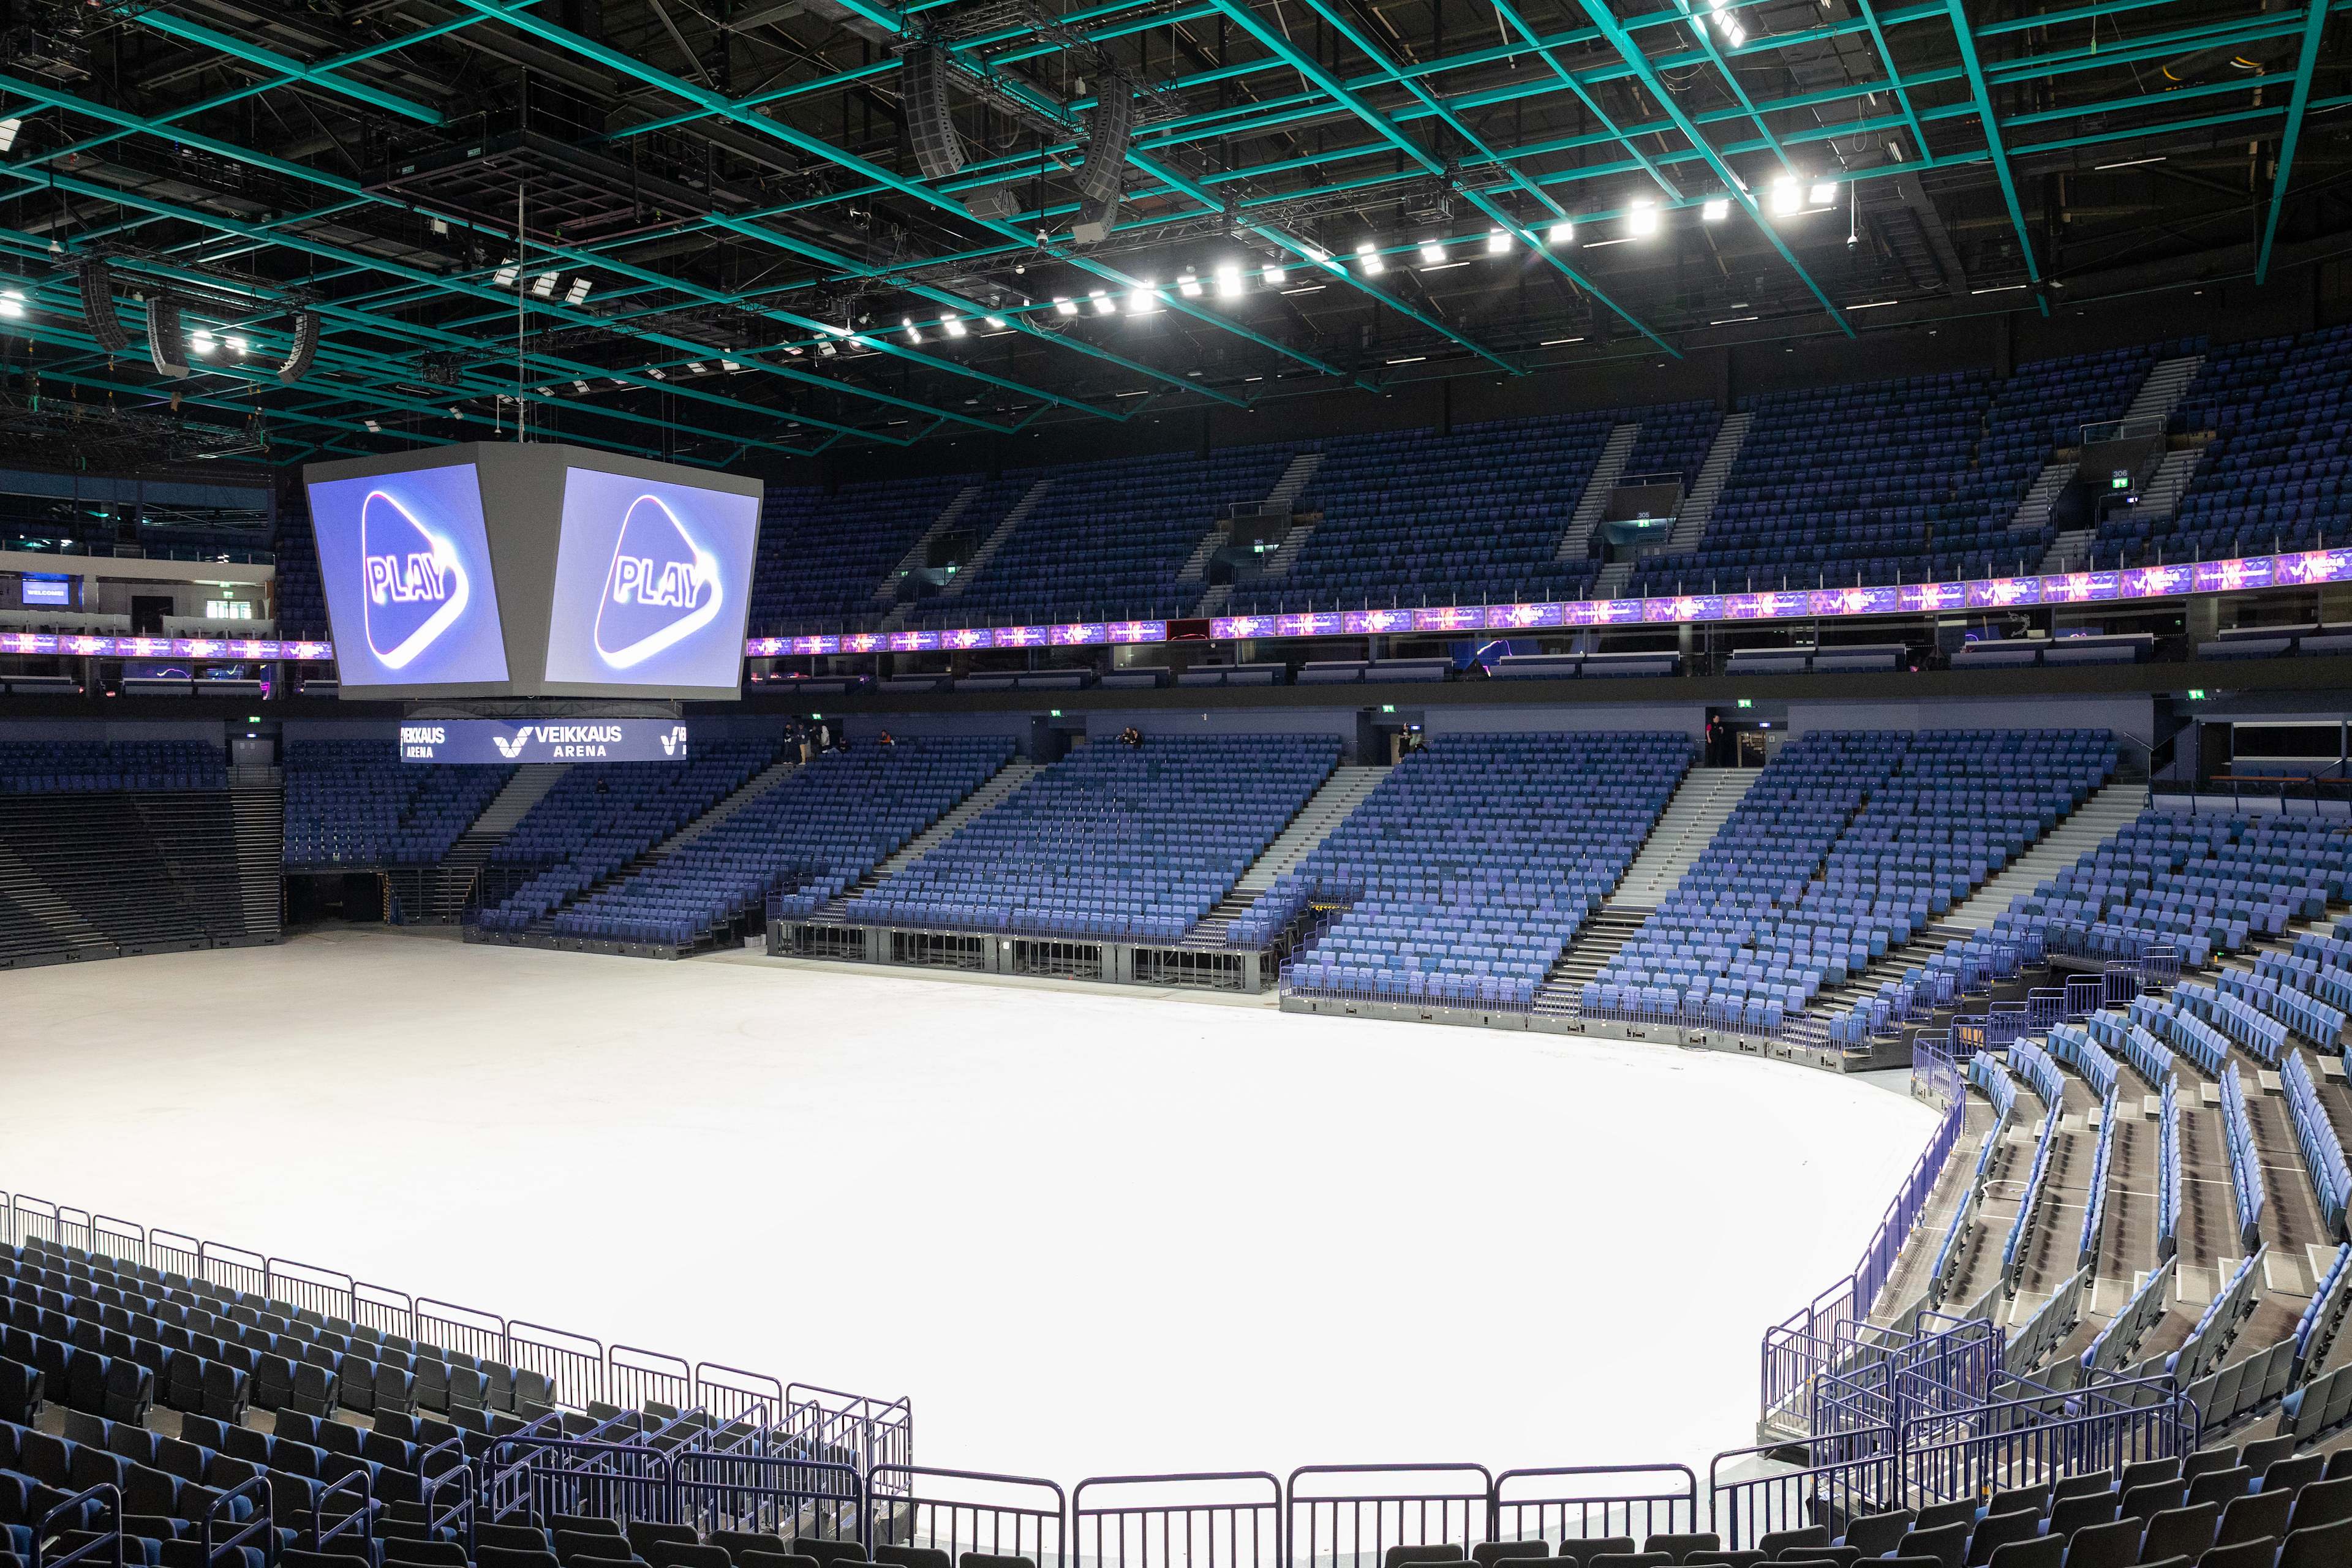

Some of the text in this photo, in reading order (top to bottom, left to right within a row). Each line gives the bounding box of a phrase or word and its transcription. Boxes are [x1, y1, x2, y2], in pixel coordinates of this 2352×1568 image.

[366, 552, 445, 605] PLAY
[614, 556, 702, 608] PLAY
[535, 726, 622, 742] VEIKKAUS
[407, 746, 434, 758] ARENA
[553, 745, 607, 758] ARENA
